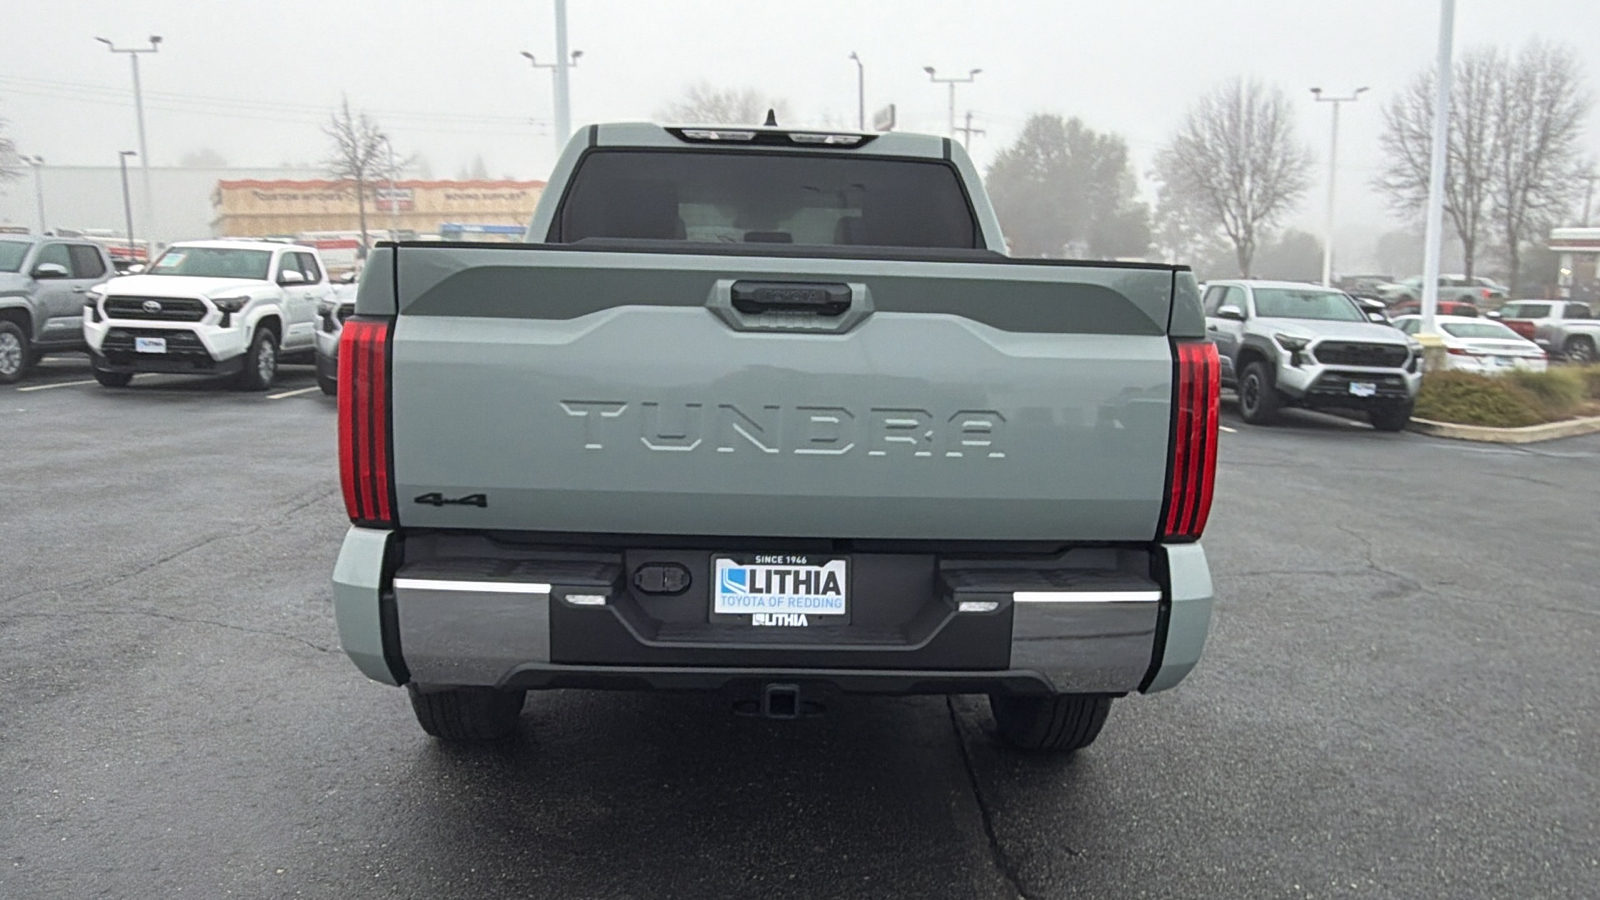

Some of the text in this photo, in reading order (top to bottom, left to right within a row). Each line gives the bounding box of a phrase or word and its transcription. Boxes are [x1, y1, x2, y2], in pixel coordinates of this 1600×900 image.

[560, 400, 1007, 458] TUNDRA
[755, 555, 808, 565] SINCE 1946
[749, 568, 842, 596] LITHIA
[720, 595, 843, 609] TOYOTA OF REDDING
[766, 613, 809, 627] LITHIA
